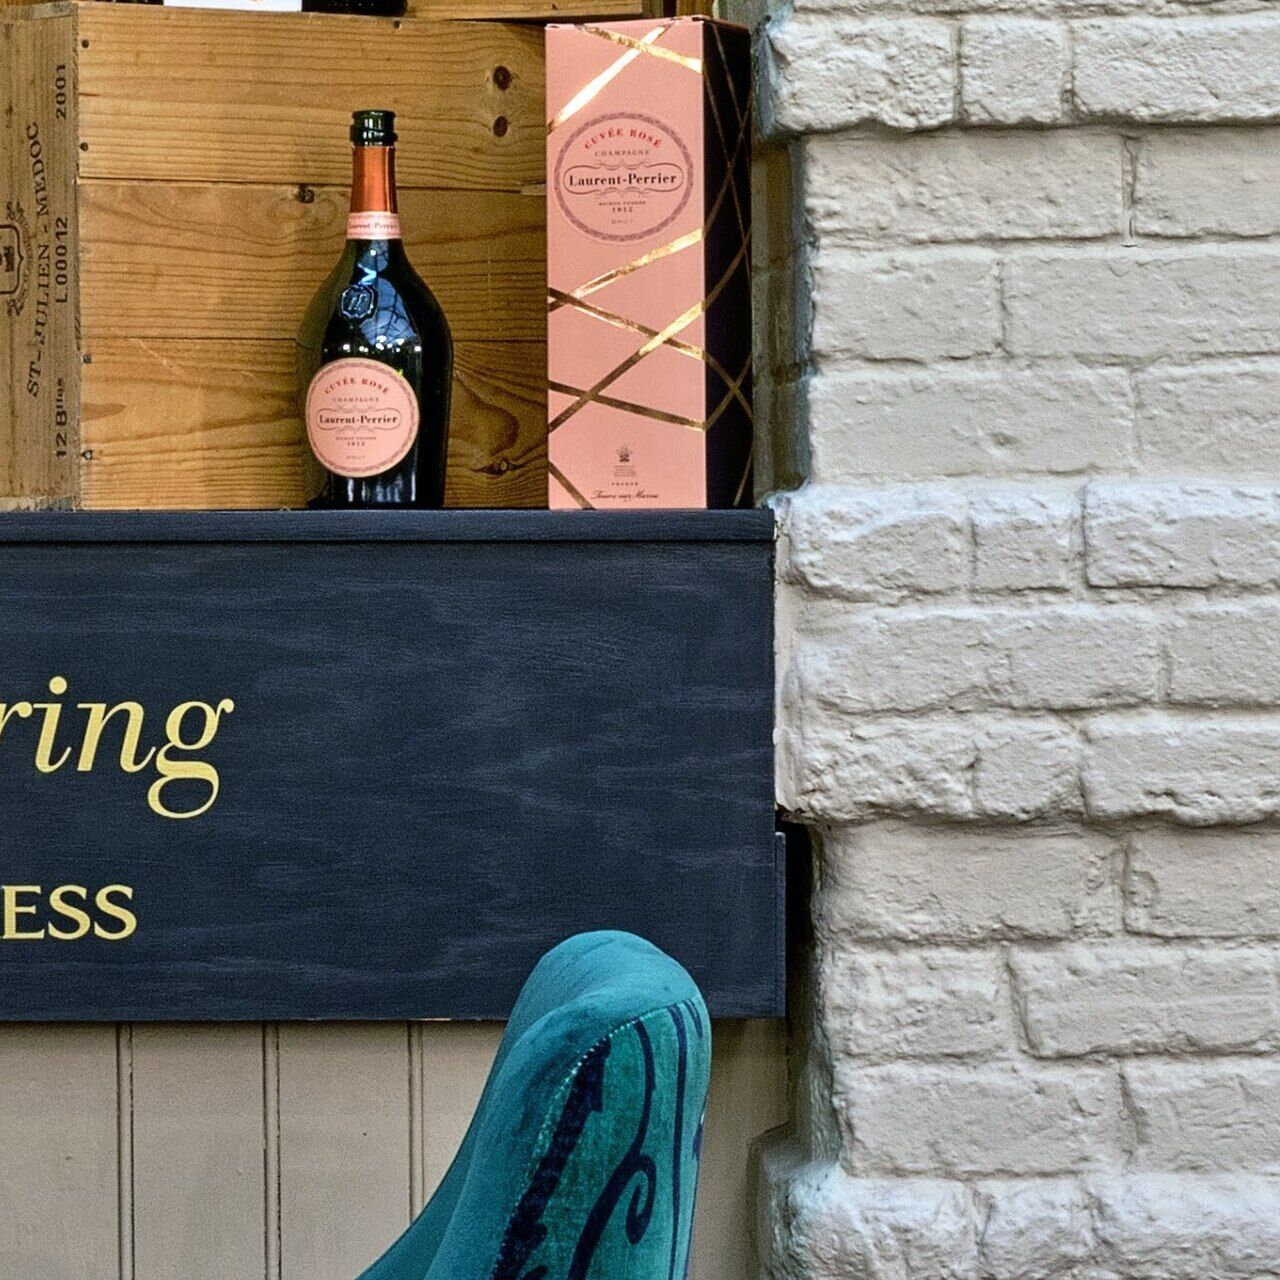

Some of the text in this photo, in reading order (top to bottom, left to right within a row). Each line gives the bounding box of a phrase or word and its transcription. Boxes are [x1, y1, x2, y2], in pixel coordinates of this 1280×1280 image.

[55, 64, 67, 120] 2001
[26, 121, 49, 216] MEDOC
[569, 172, 677, 187] Laurent-Perrier
[319, 413, 398, 424] Laurent-Perrier
[56, 432, 67, 456] 12
